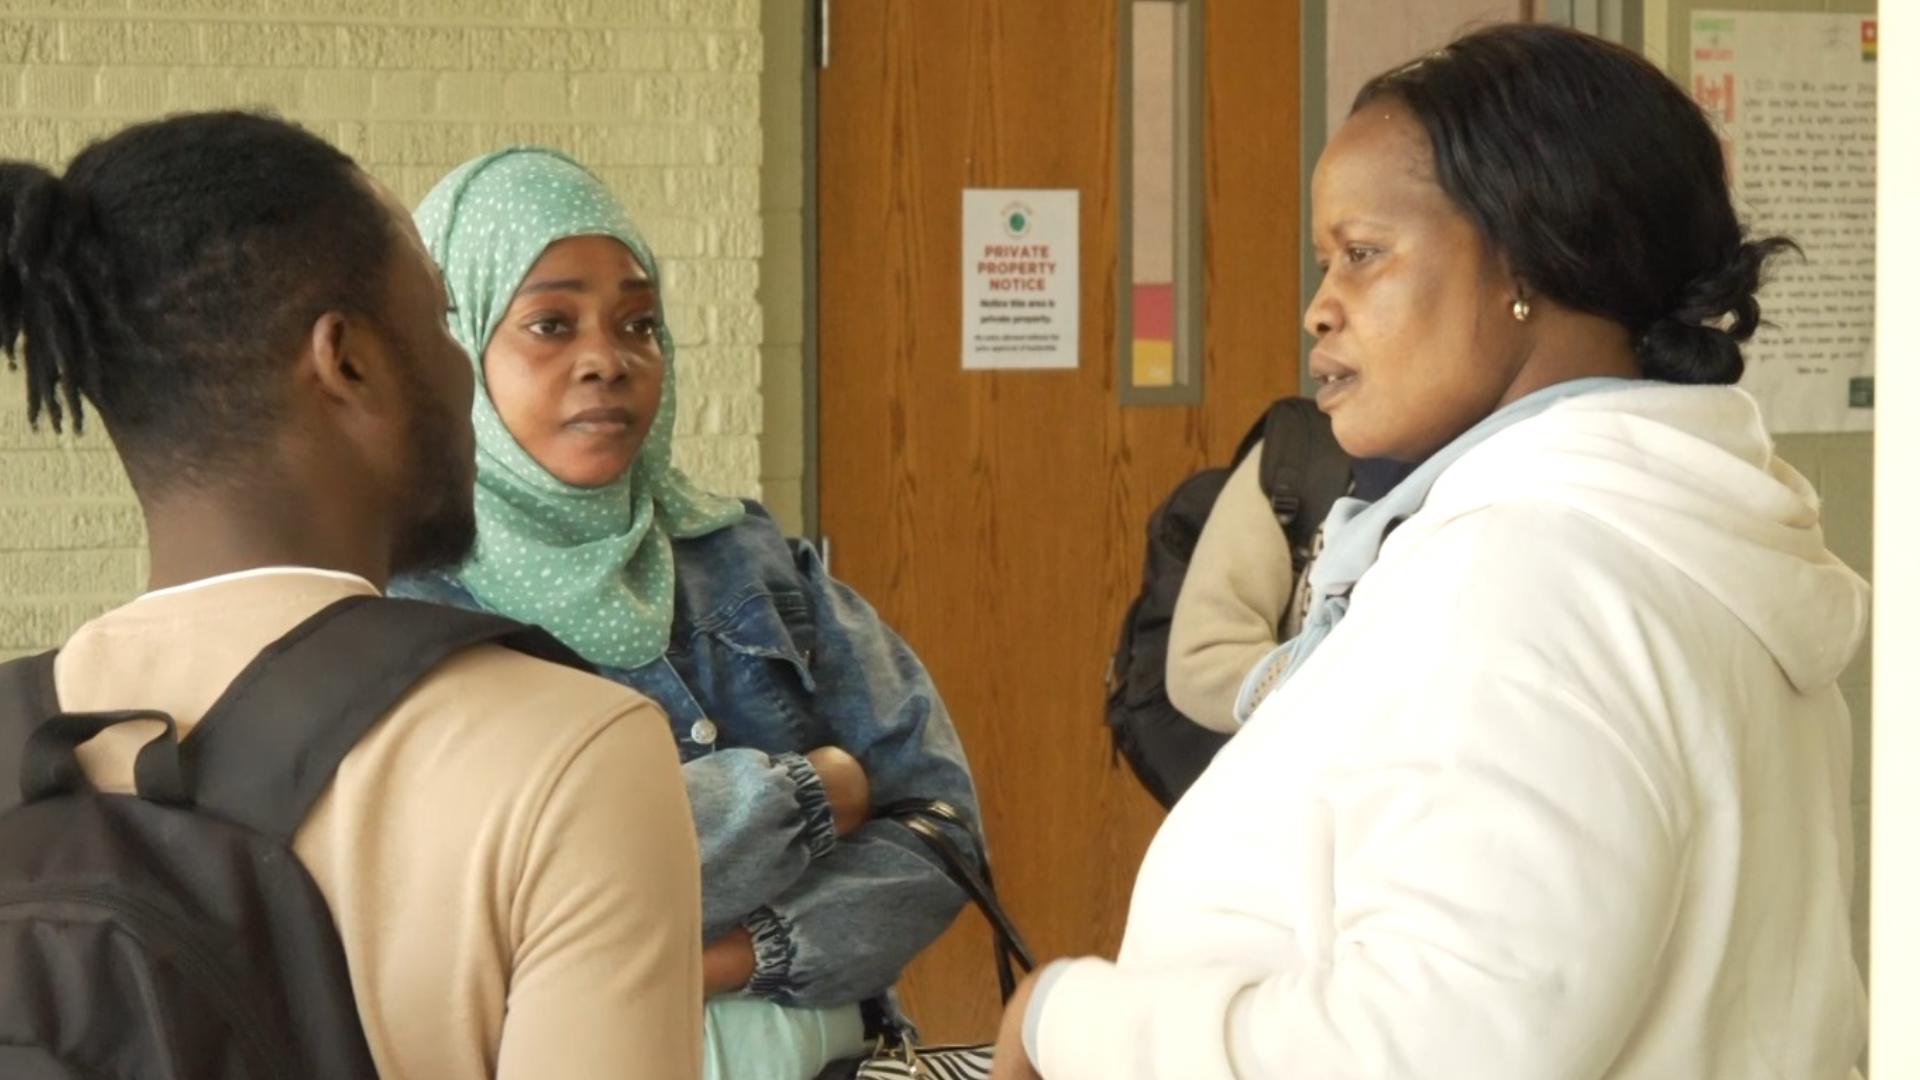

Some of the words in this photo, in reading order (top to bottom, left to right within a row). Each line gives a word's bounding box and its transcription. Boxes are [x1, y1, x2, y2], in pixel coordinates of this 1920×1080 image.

[984, 245, 1050, 258] PRIVATE
[977, 262, 1057, 275] PROPERTY
[989, 278, 1046, 291] NOTICE
[980, 299, 1009, 308] Notice
[980, 315, 1011, 325] private
